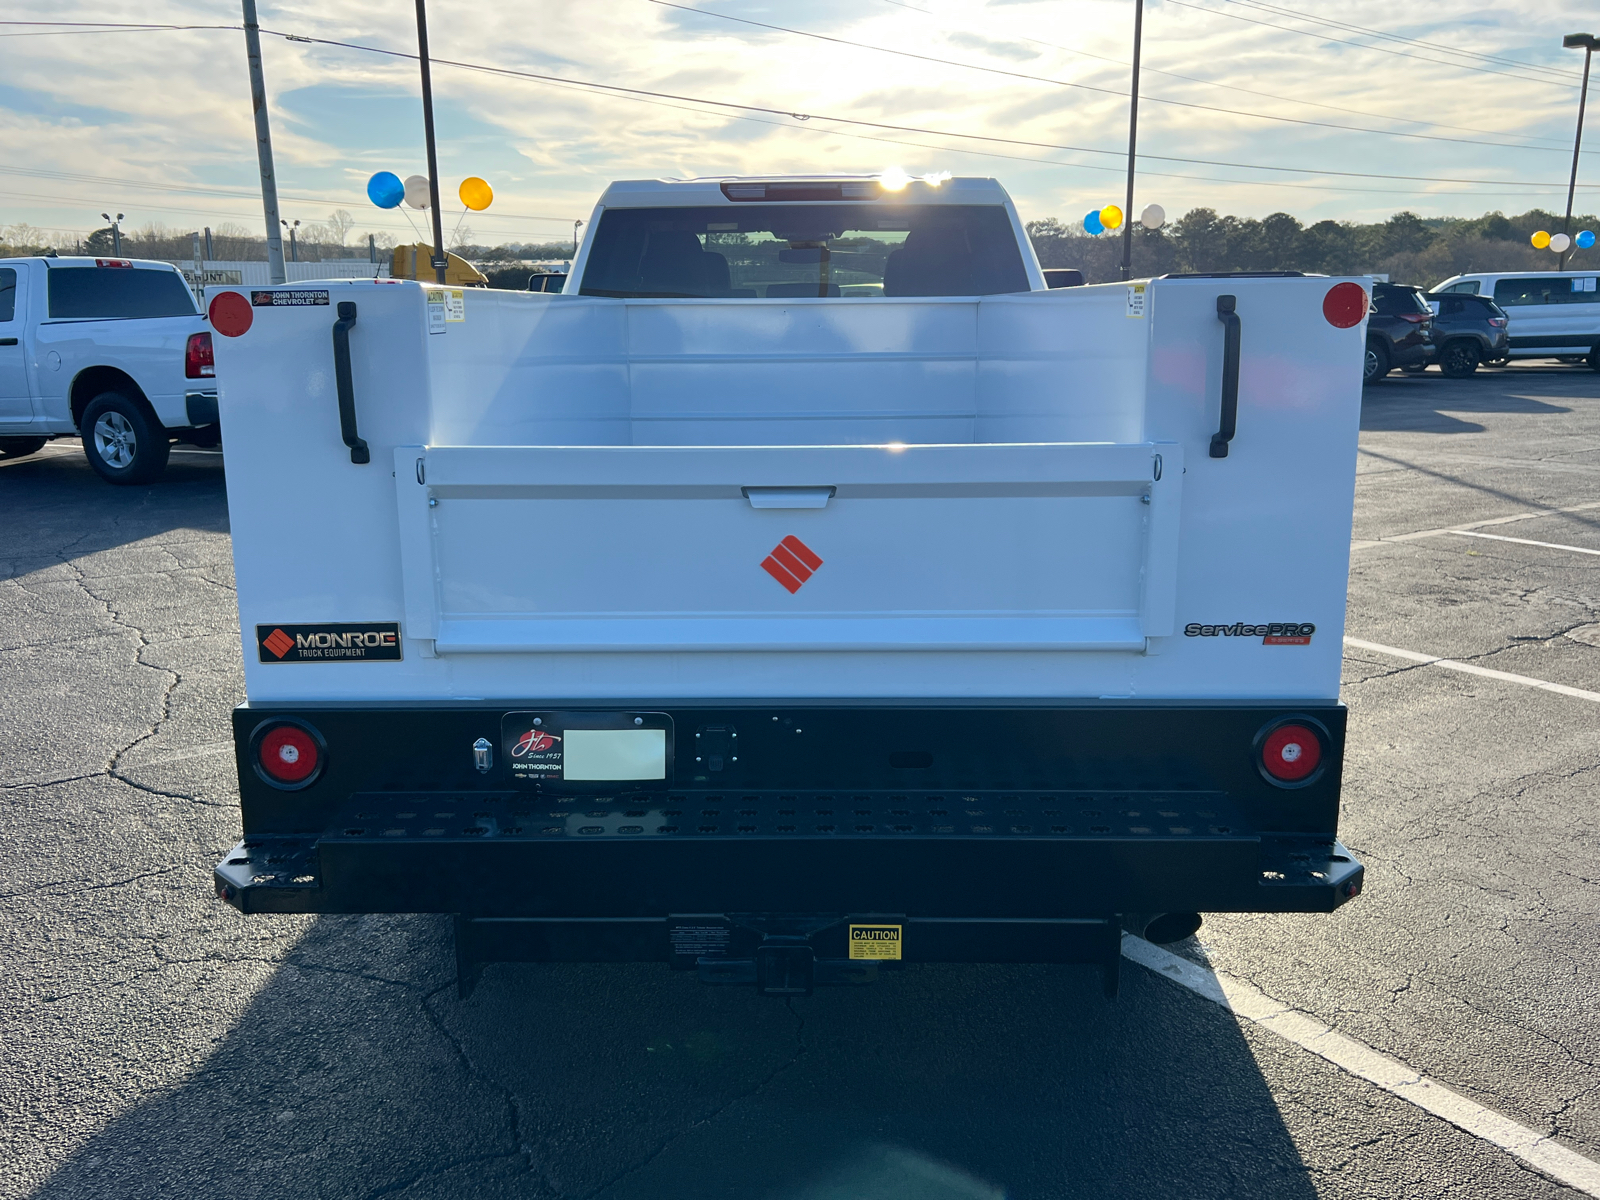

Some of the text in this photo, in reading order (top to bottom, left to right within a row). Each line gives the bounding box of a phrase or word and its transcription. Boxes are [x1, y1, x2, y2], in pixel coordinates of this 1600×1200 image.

[272, 291, 290, 299] JOHN
[1184, 622, 1315, 638] ServicePRO
[296, 632, 396, 649] MONROE
[298, 648, 366, 657] TRUCK EQUIPMENT
[546, 752, 562, 760] 1957
[853, 930, 898, 940] CAUTION
